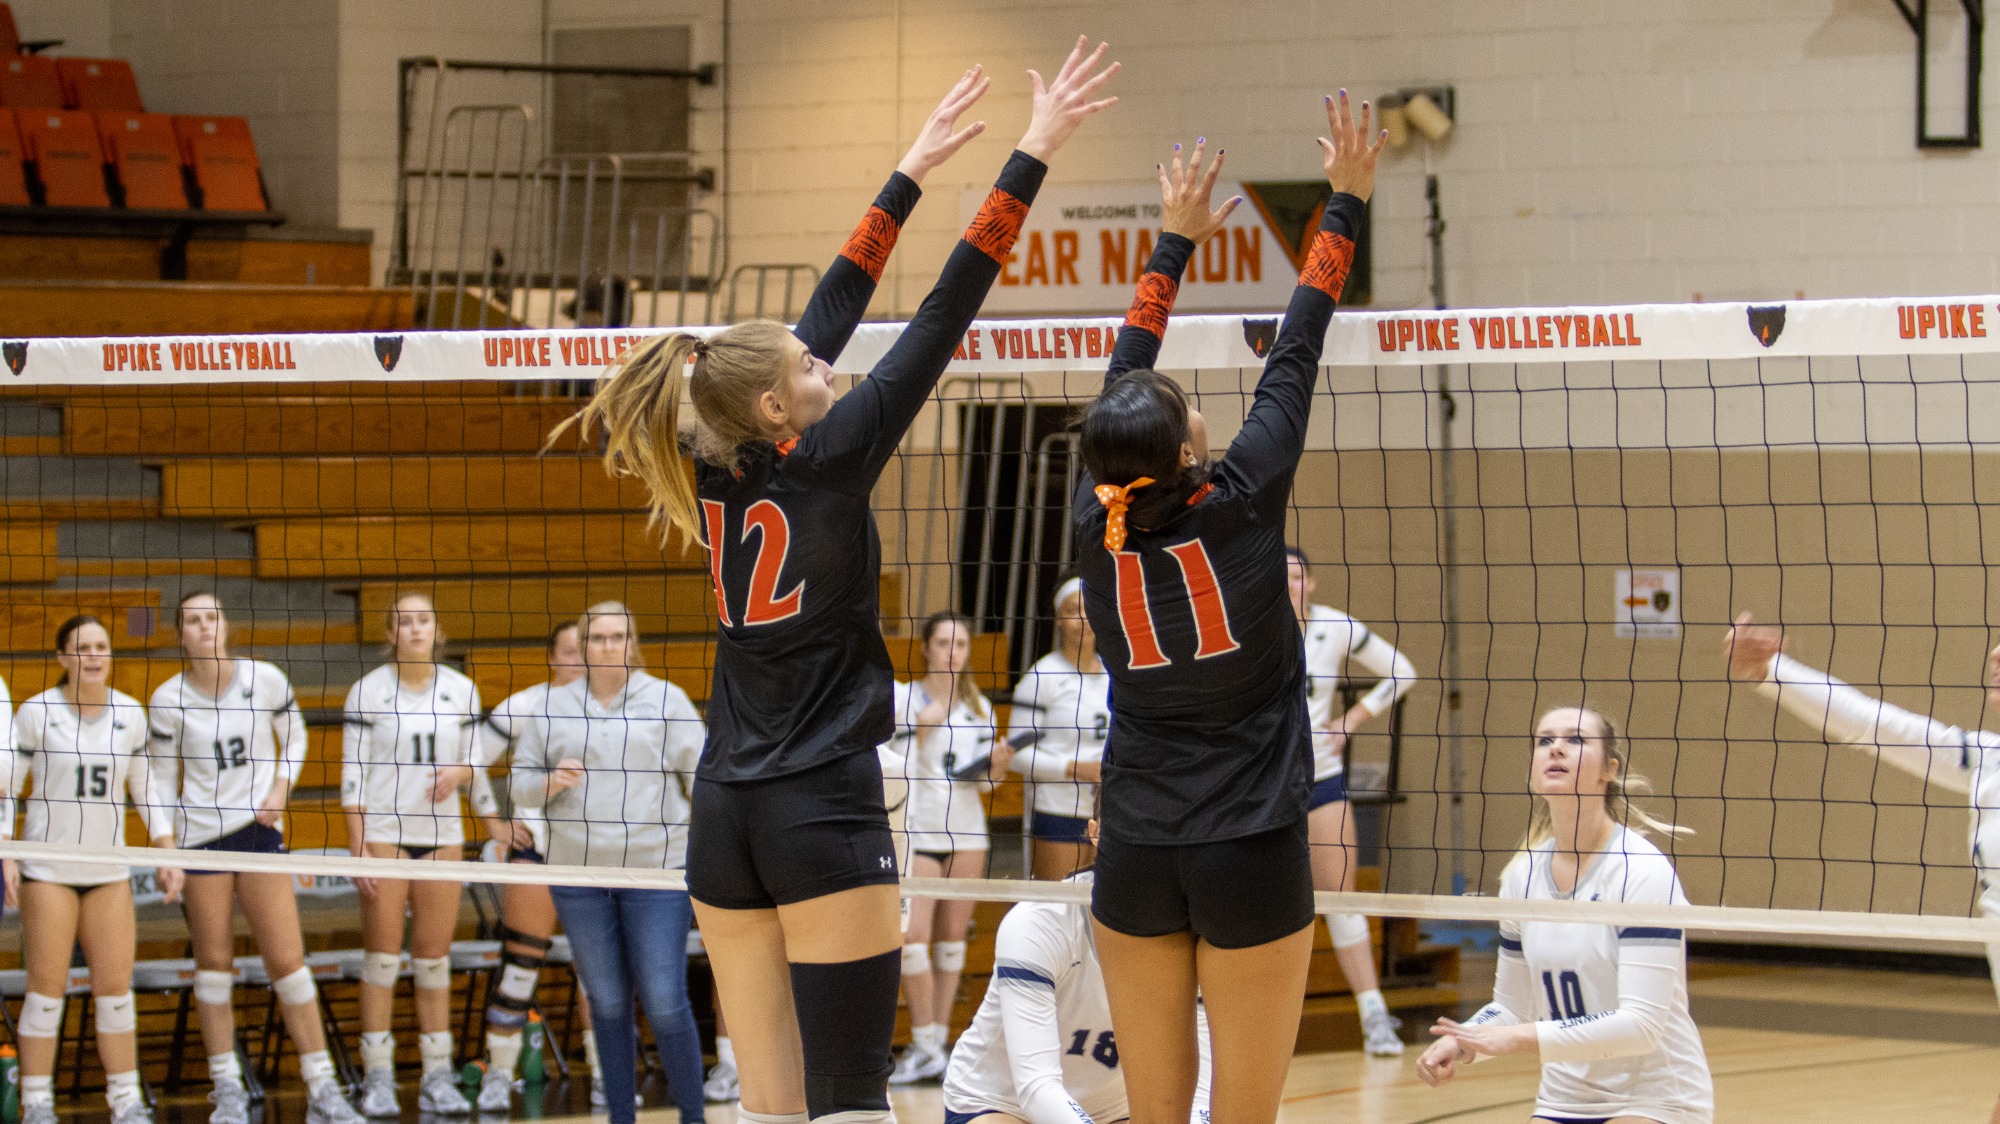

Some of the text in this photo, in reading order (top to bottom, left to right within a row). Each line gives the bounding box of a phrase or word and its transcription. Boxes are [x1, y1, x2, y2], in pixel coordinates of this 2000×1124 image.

[1061, 203, 1161, 220] WELCOME TO
[1000, 230, 1079, 286] EAR
[1377, 313, 1642, 352] UPIKE VOLLEYBALL
[1897, 304, 1986, 339] UPIKE
[103, 341, 296, 371] UPIKE VOLLEYBALL
[484, 337, 551, 367] UPIKE
[990, 327, 1122, 360] VOLLEYBA
[698, 498, 805, 628] 12
[1108, 537, 1241, 670] 11
[213, 735, 248, 771] 12
[412, 731, 436, 763] 11
[75, 764, 108, 798] 15
[1541, 969, 1587, 1021] 10
[1065, 1028, 1120, 1070] 18
